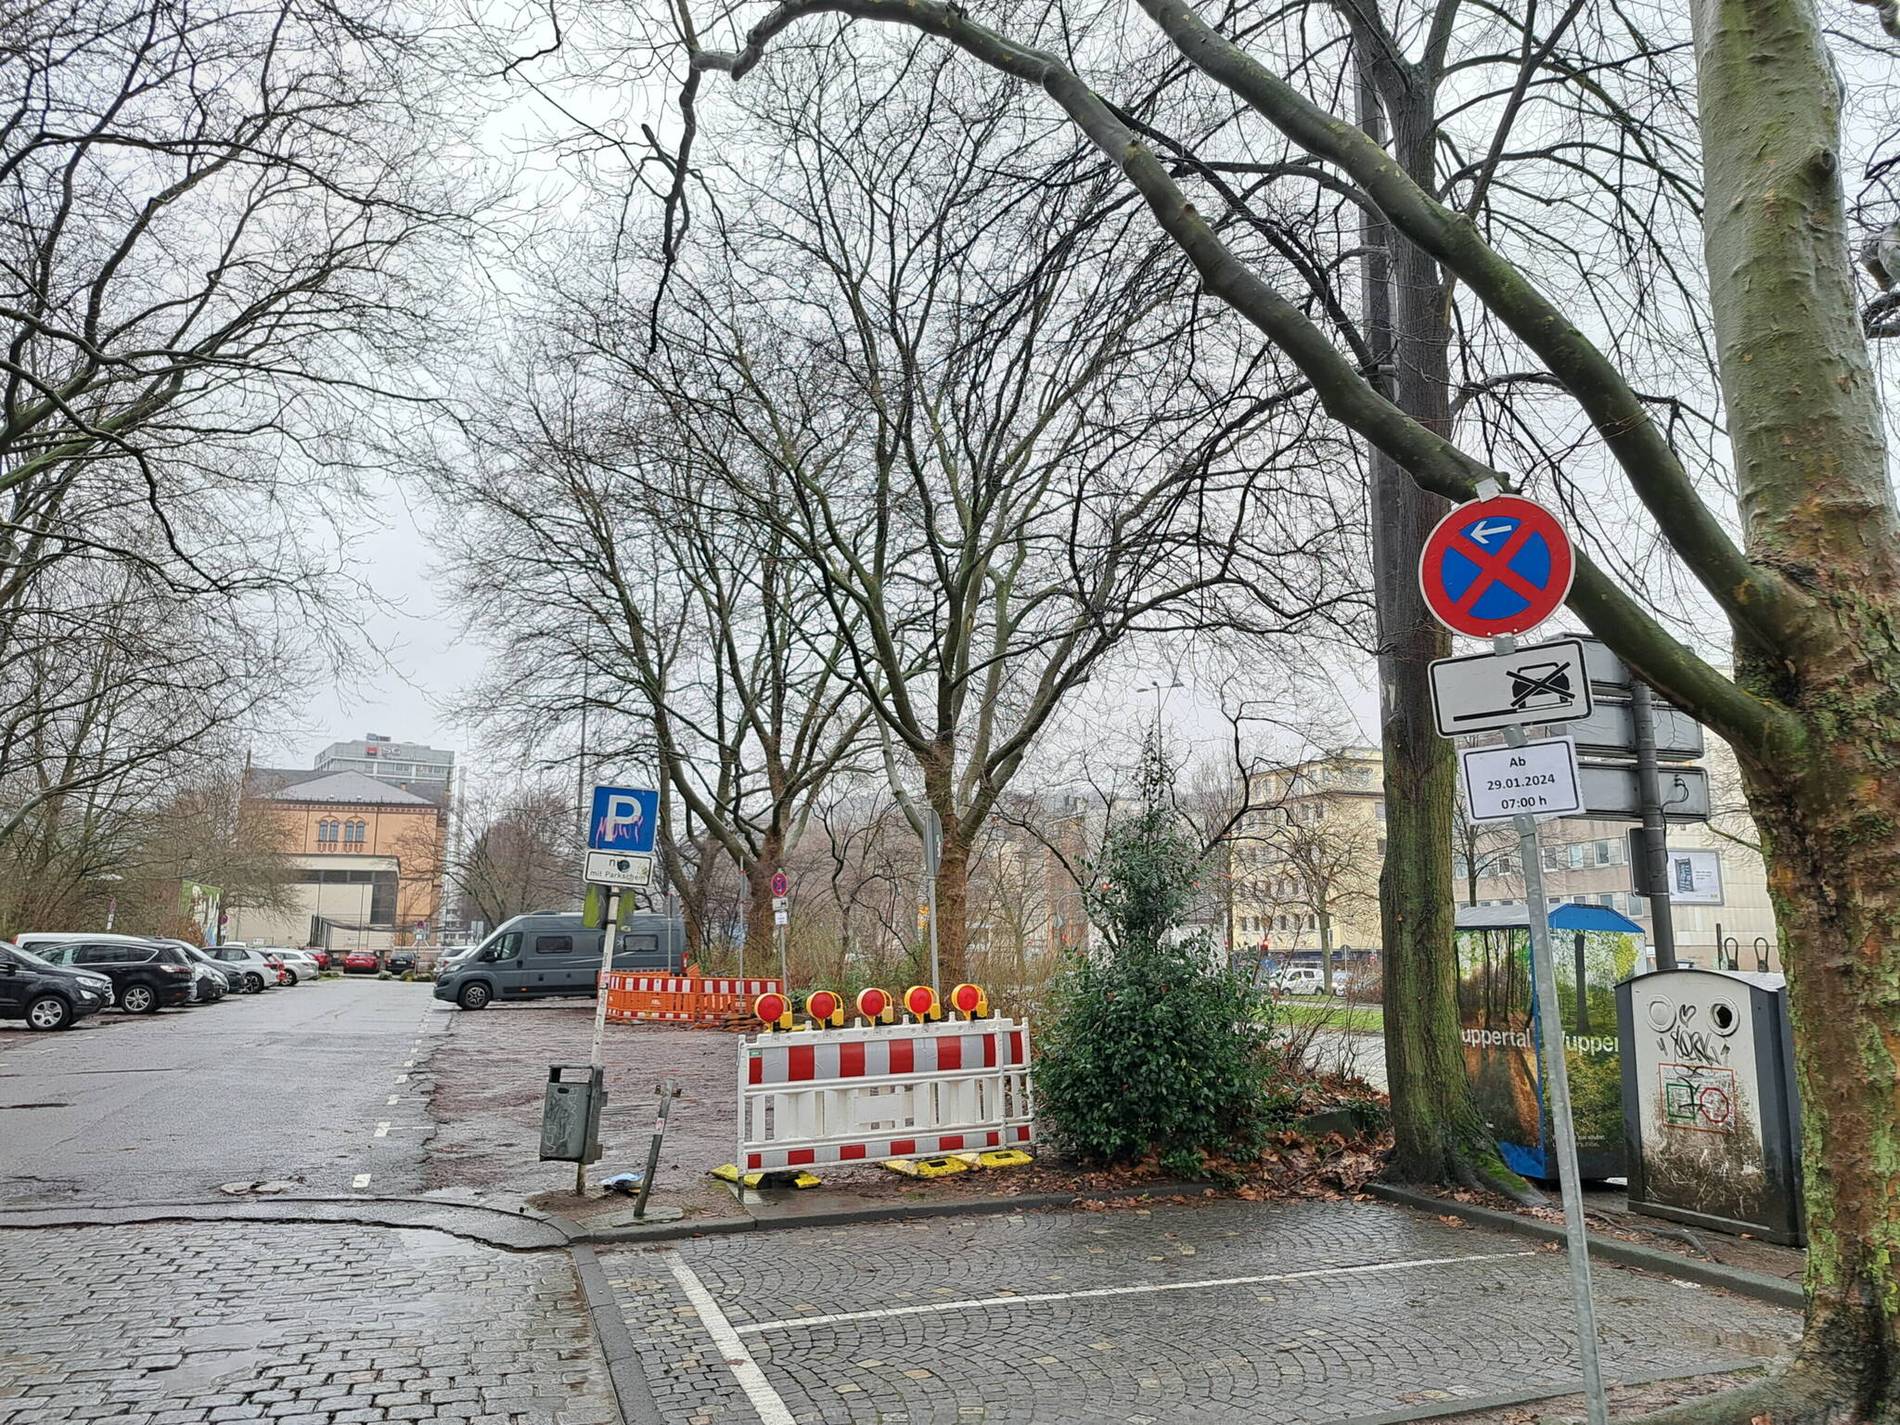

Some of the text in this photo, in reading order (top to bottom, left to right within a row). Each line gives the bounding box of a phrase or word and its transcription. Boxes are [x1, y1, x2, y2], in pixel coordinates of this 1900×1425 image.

[1509, 757, 1527, 768] Ab
[1487, 773, 1556, 791] 29.01.2024
[1501, 795, 1548, 810] 07:00 h
[604, 795, 642, 842] P
[605, 870, 646, 882] Parkschein
[1461, 1027, 1532, 1049] uppertal
